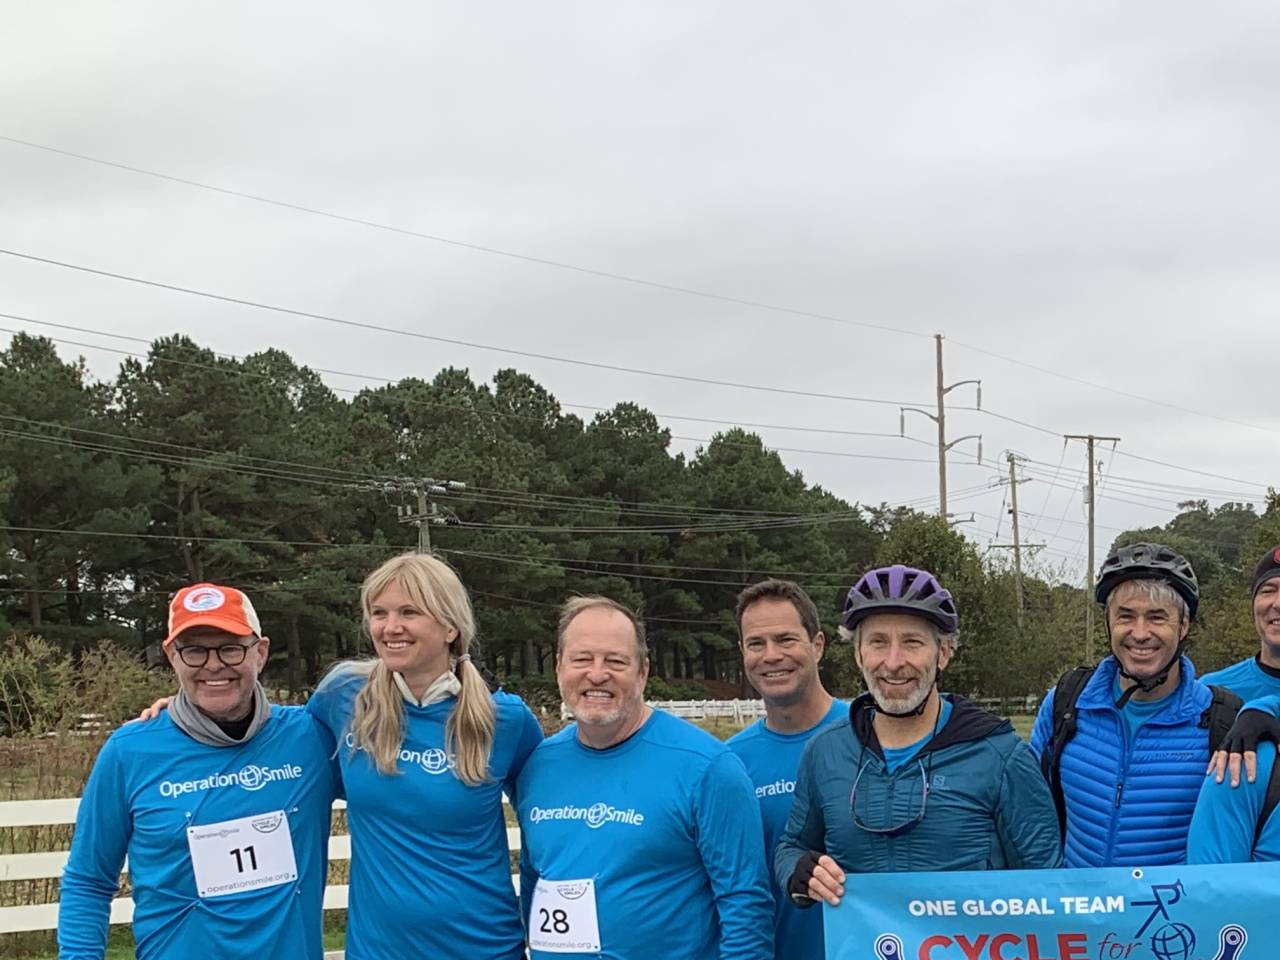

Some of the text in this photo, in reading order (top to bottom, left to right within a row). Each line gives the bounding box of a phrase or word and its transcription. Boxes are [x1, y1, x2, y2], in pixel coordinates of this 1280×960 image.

[159, 764, 302, 798] Operation Smile
[755, 779, 797, 798] eratio
[530, 805, 644, 825] Operation Smile
[230, 845, 257, 873] 11
[908, 896, 1125, 917] ONE GLOBAL TEAM
[539, 908, 570, 934] 28
[1098, 931, 1143, 960] for
